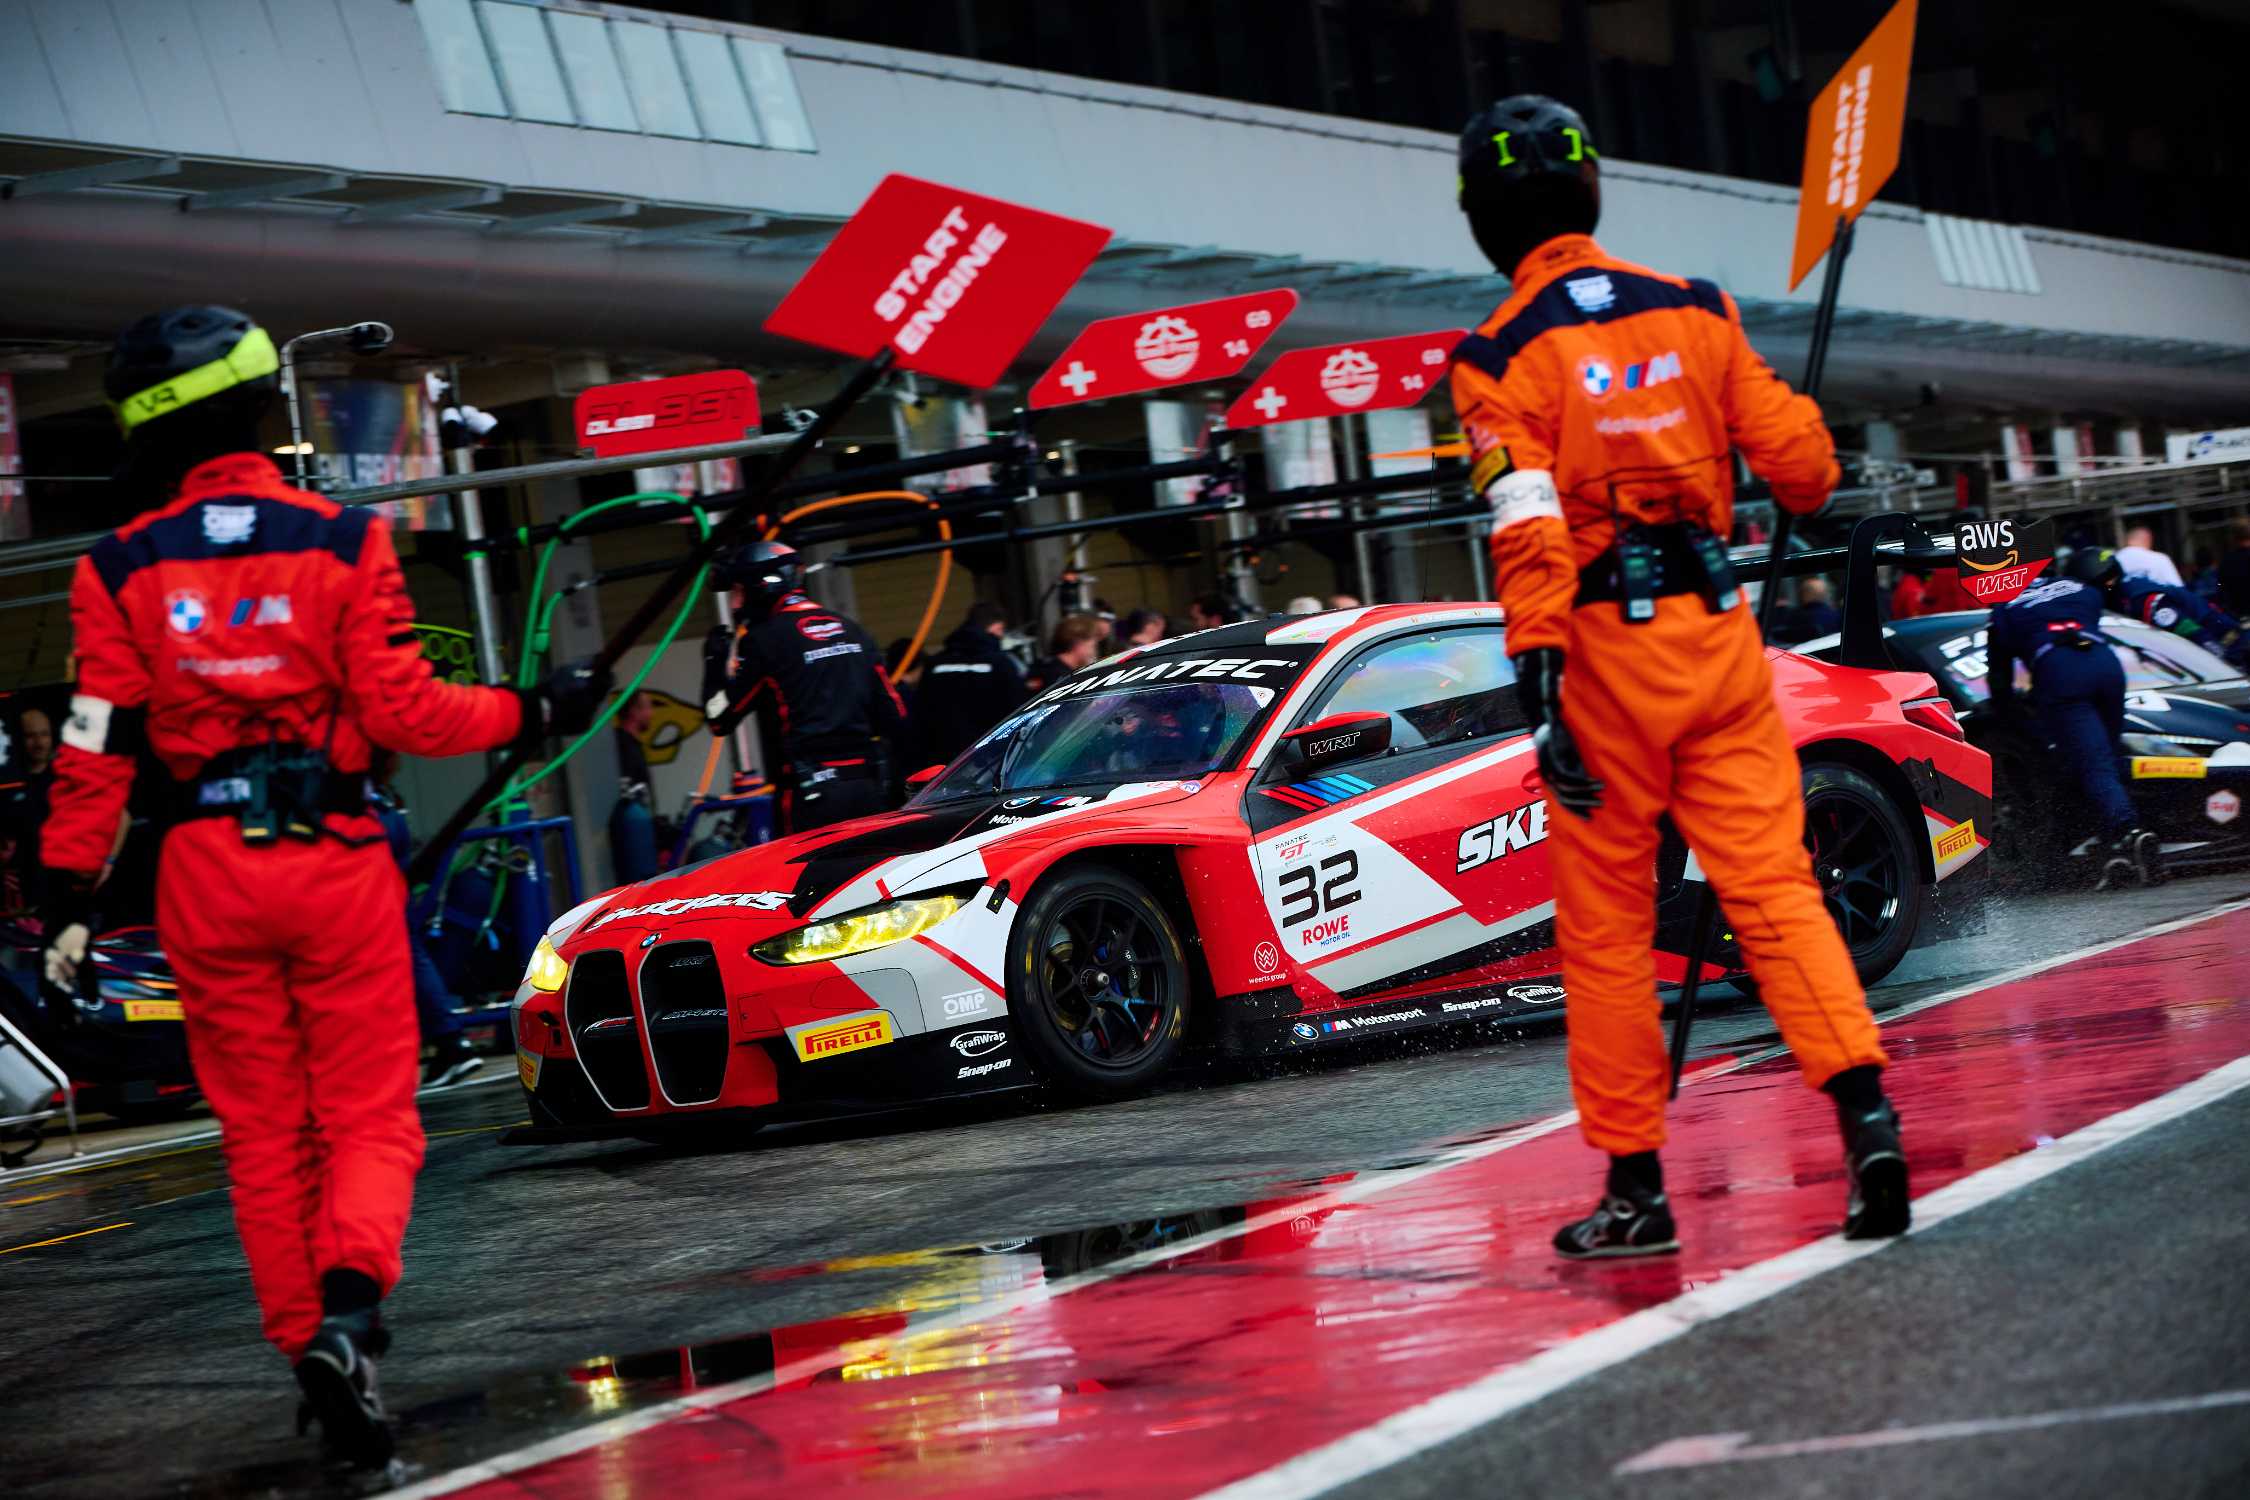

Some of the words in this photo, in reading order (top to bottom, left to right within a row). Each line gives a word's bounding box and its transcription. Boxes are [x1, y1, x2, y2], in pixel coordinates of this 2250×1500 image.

[1826, 81, 1854, 206] START
[1841, 64, 1873, 209] ENGINE
[873, 205, 969, 322] START
[894, 222, 1008, 355] ENGINE
[1961, 520, 2015, 551] aws
[1976, 567, 2029, 597] WRT
[1023, 658, 1290, 712] FANATEC
[1309, 731, 1361, 757] WRT
[1936, 826, 1972, 858] PIRELLI
[1279, 849, 1362, 929] 32
[1302, 914, 1349, 946] ROWE
[1320, 936, 1341, 947] MOTOR
[943, 992, 986, 1016] OMP
[1351, 1008, 1427, 1028] Motorsport
[1442, 997, 1502, 1014] Snap-on
[804, 1020, 883, 1056] PIRELLI
[955, 1032, 1006, 1051] GrafiWrap
[957, 1058, 1012, 1079] Snap-on
